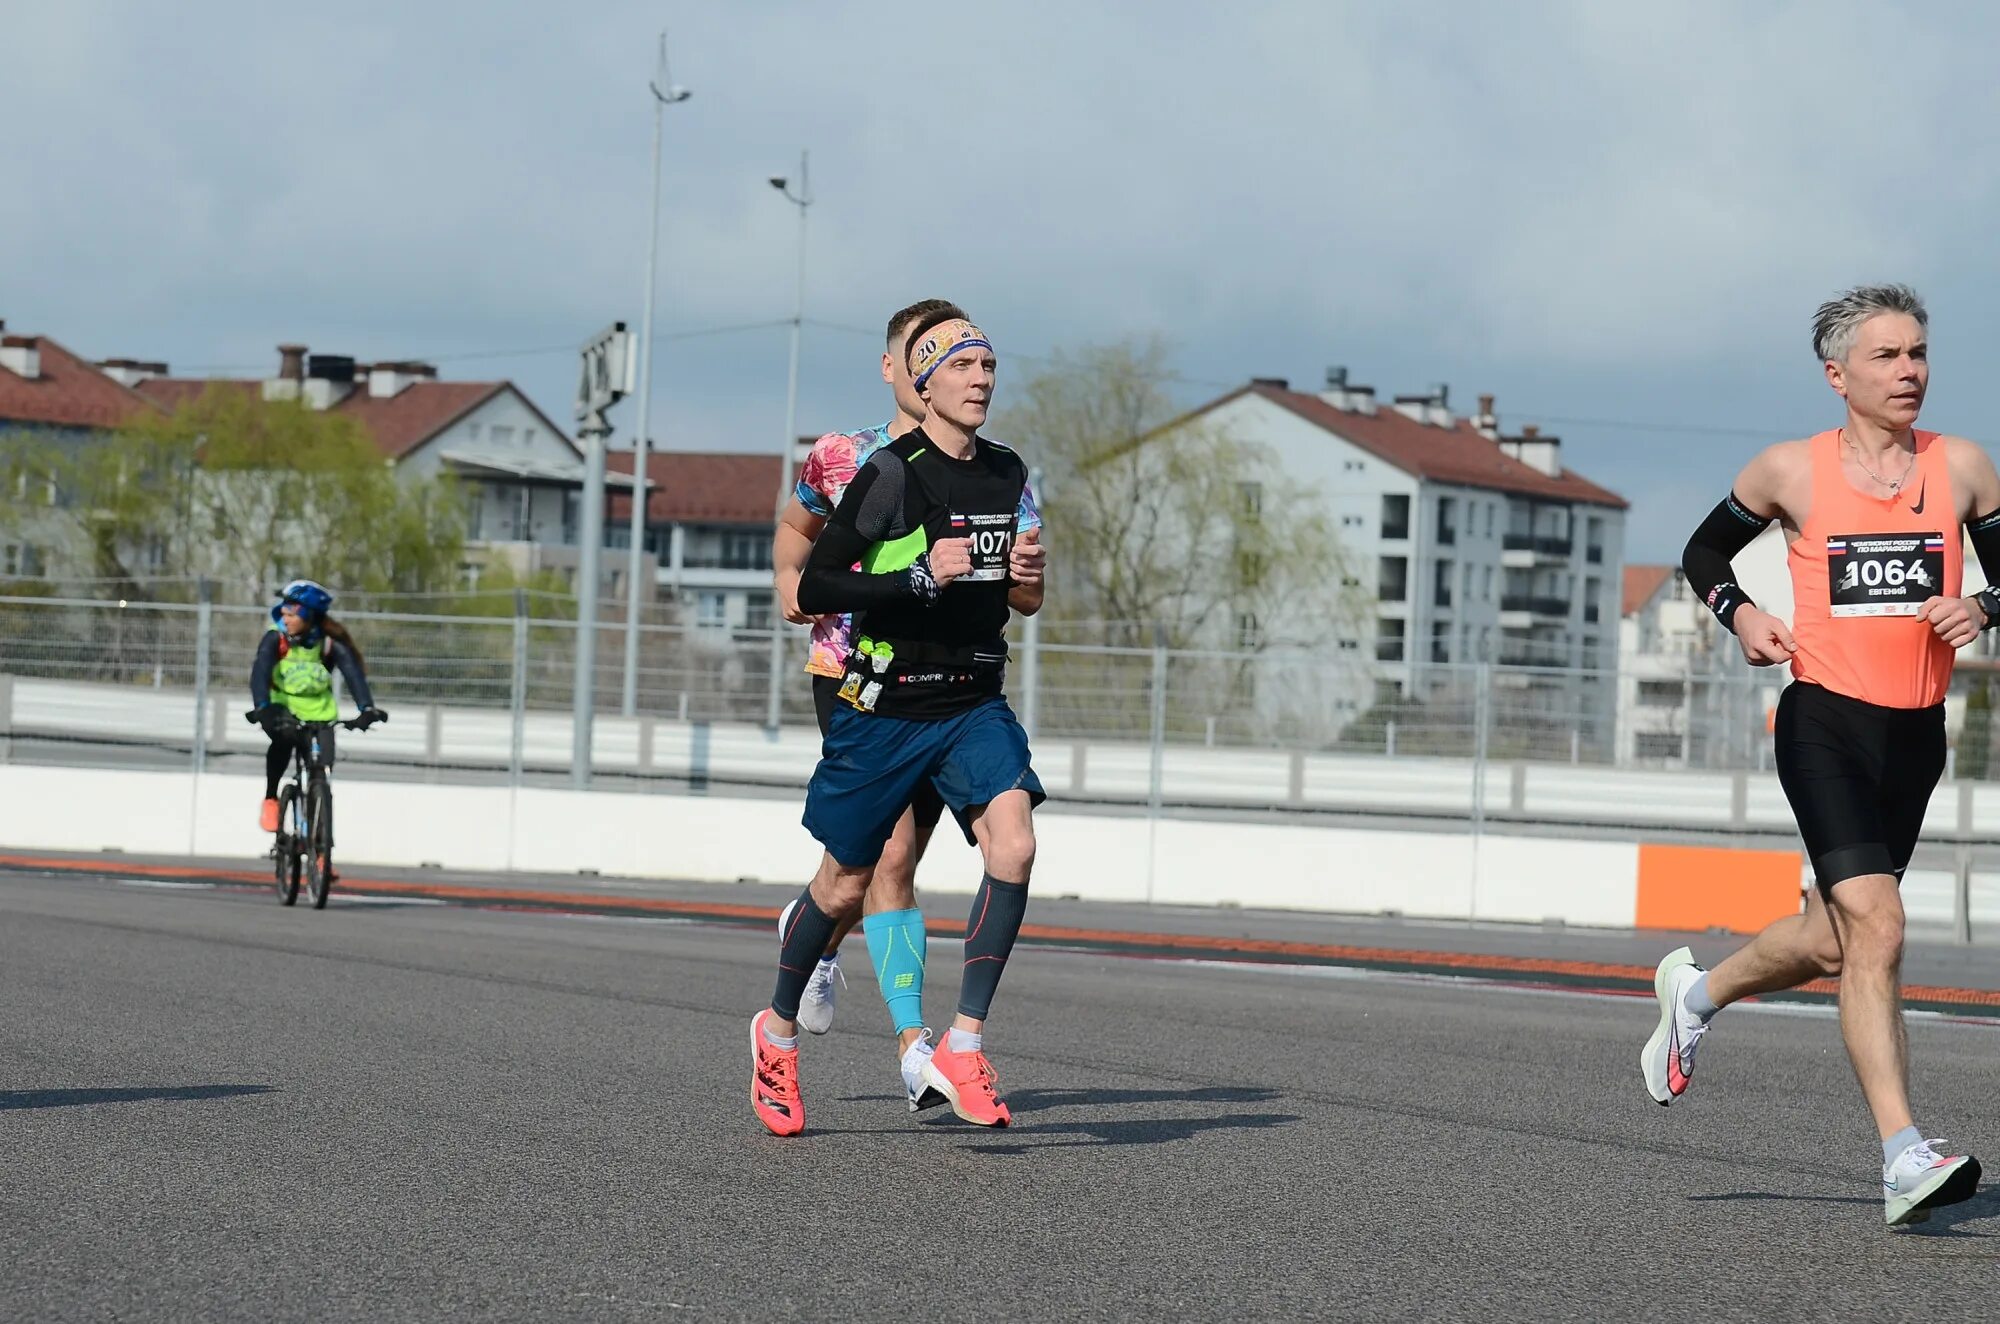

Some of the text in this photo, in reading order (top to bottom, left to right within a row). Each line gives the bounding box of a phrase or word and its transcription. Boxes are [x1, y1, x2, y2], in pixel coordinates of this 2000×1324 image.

[961, 330, 971, 338] di
[918, 340, 937, 364] 20
[1857, 545, 1917, 554] ПО МАРАФОНУ
[1846, 559, 1927, 586] 1064
[1868, 586, 1906, 595] ЕВГЕНИЙ
